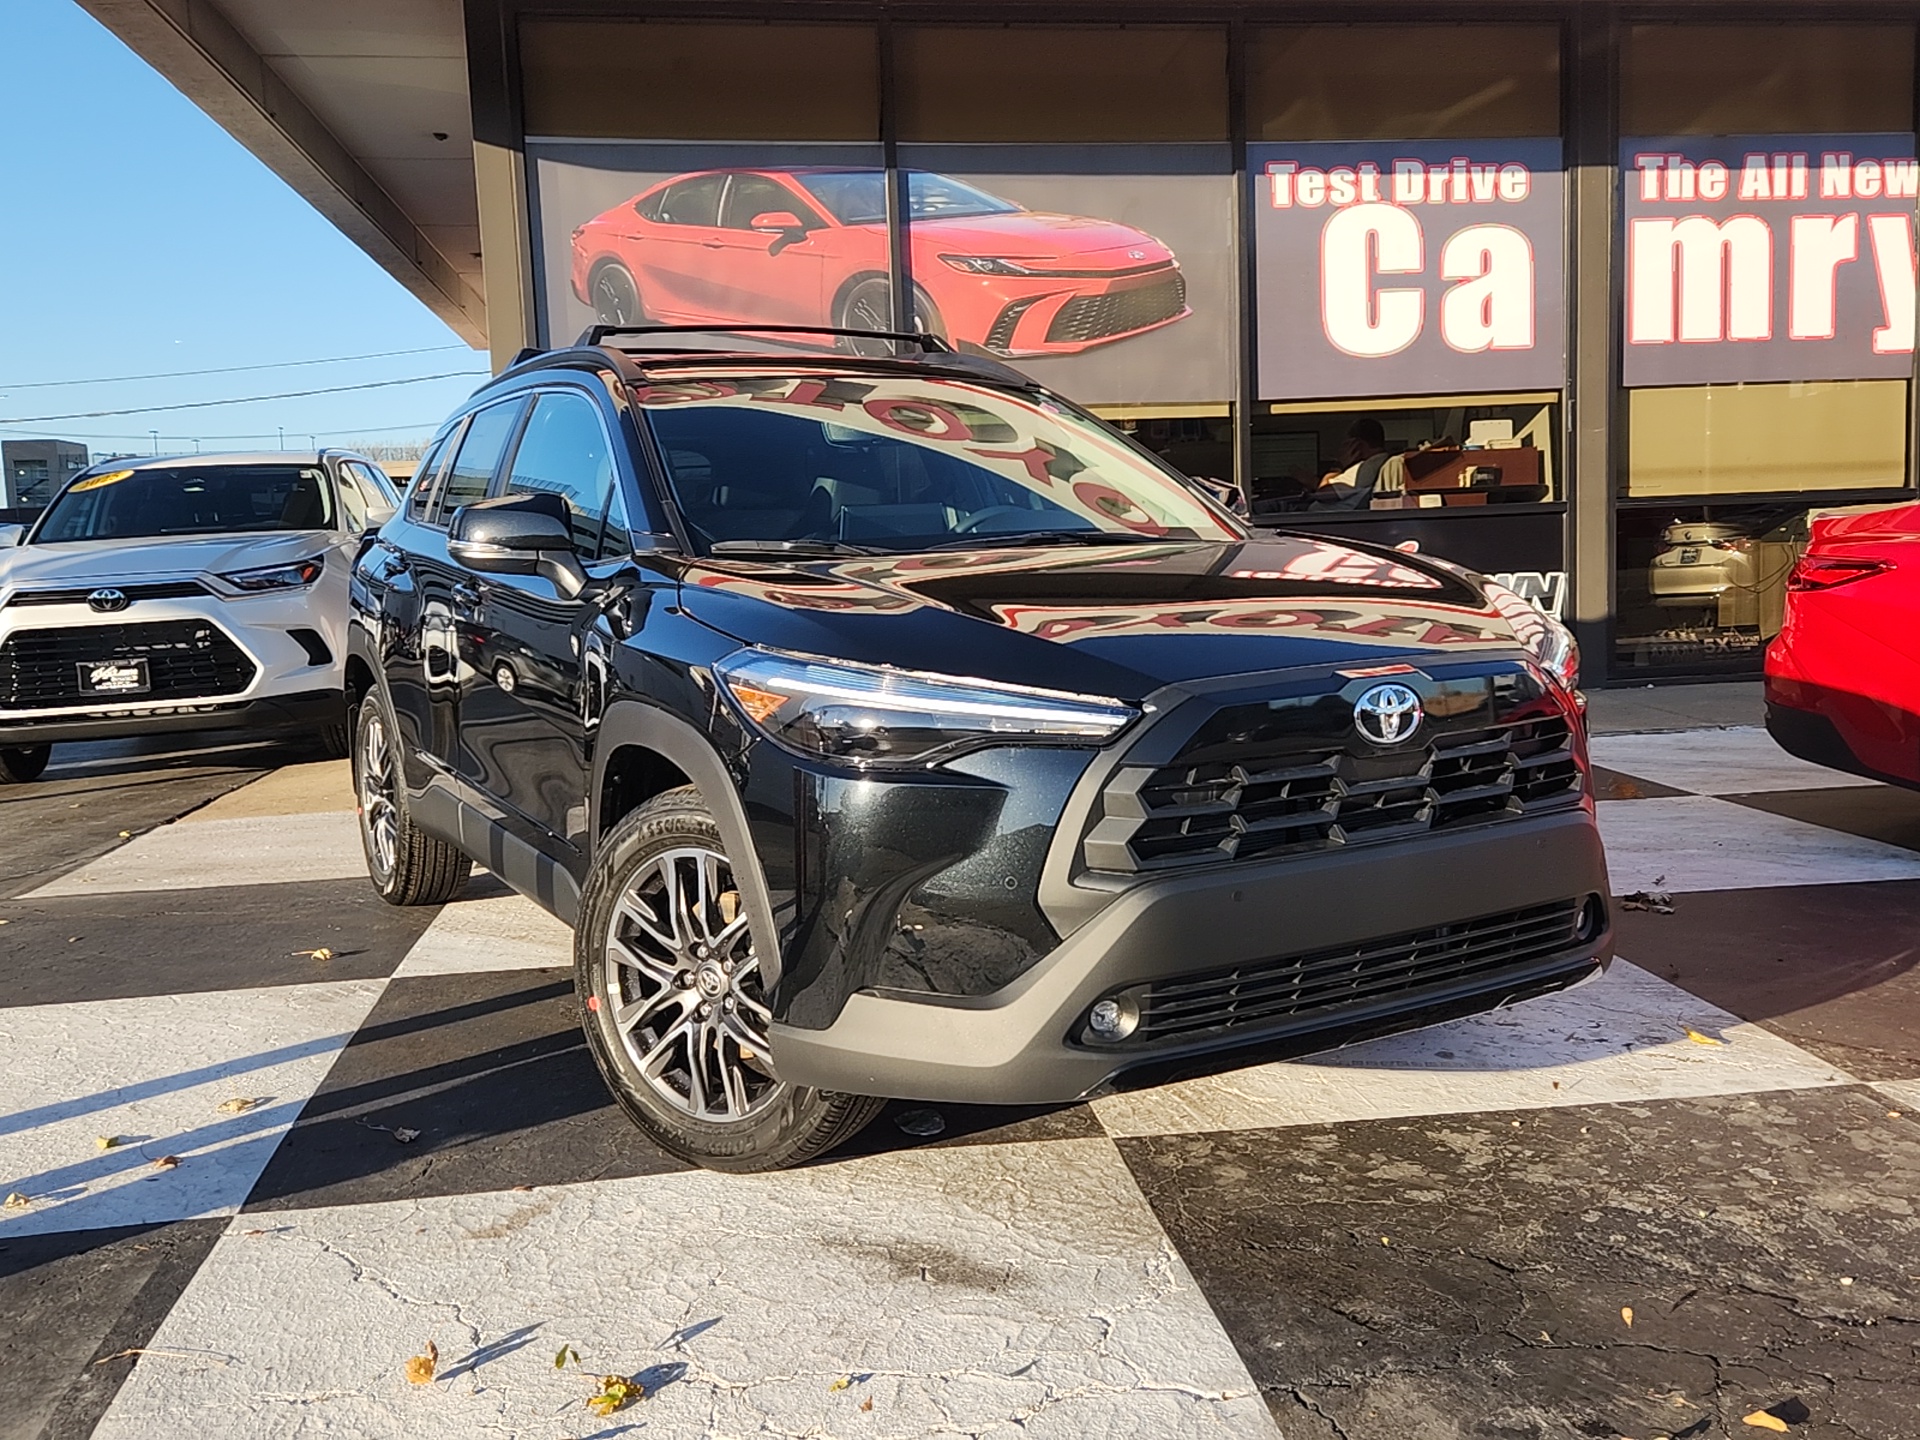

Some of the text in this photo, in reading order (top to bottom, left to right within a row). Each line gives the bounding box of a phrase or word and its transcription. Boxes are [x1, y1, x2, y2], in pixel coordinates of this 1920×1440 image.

[1265, 151, 1920, 208] Test Drive The All New
